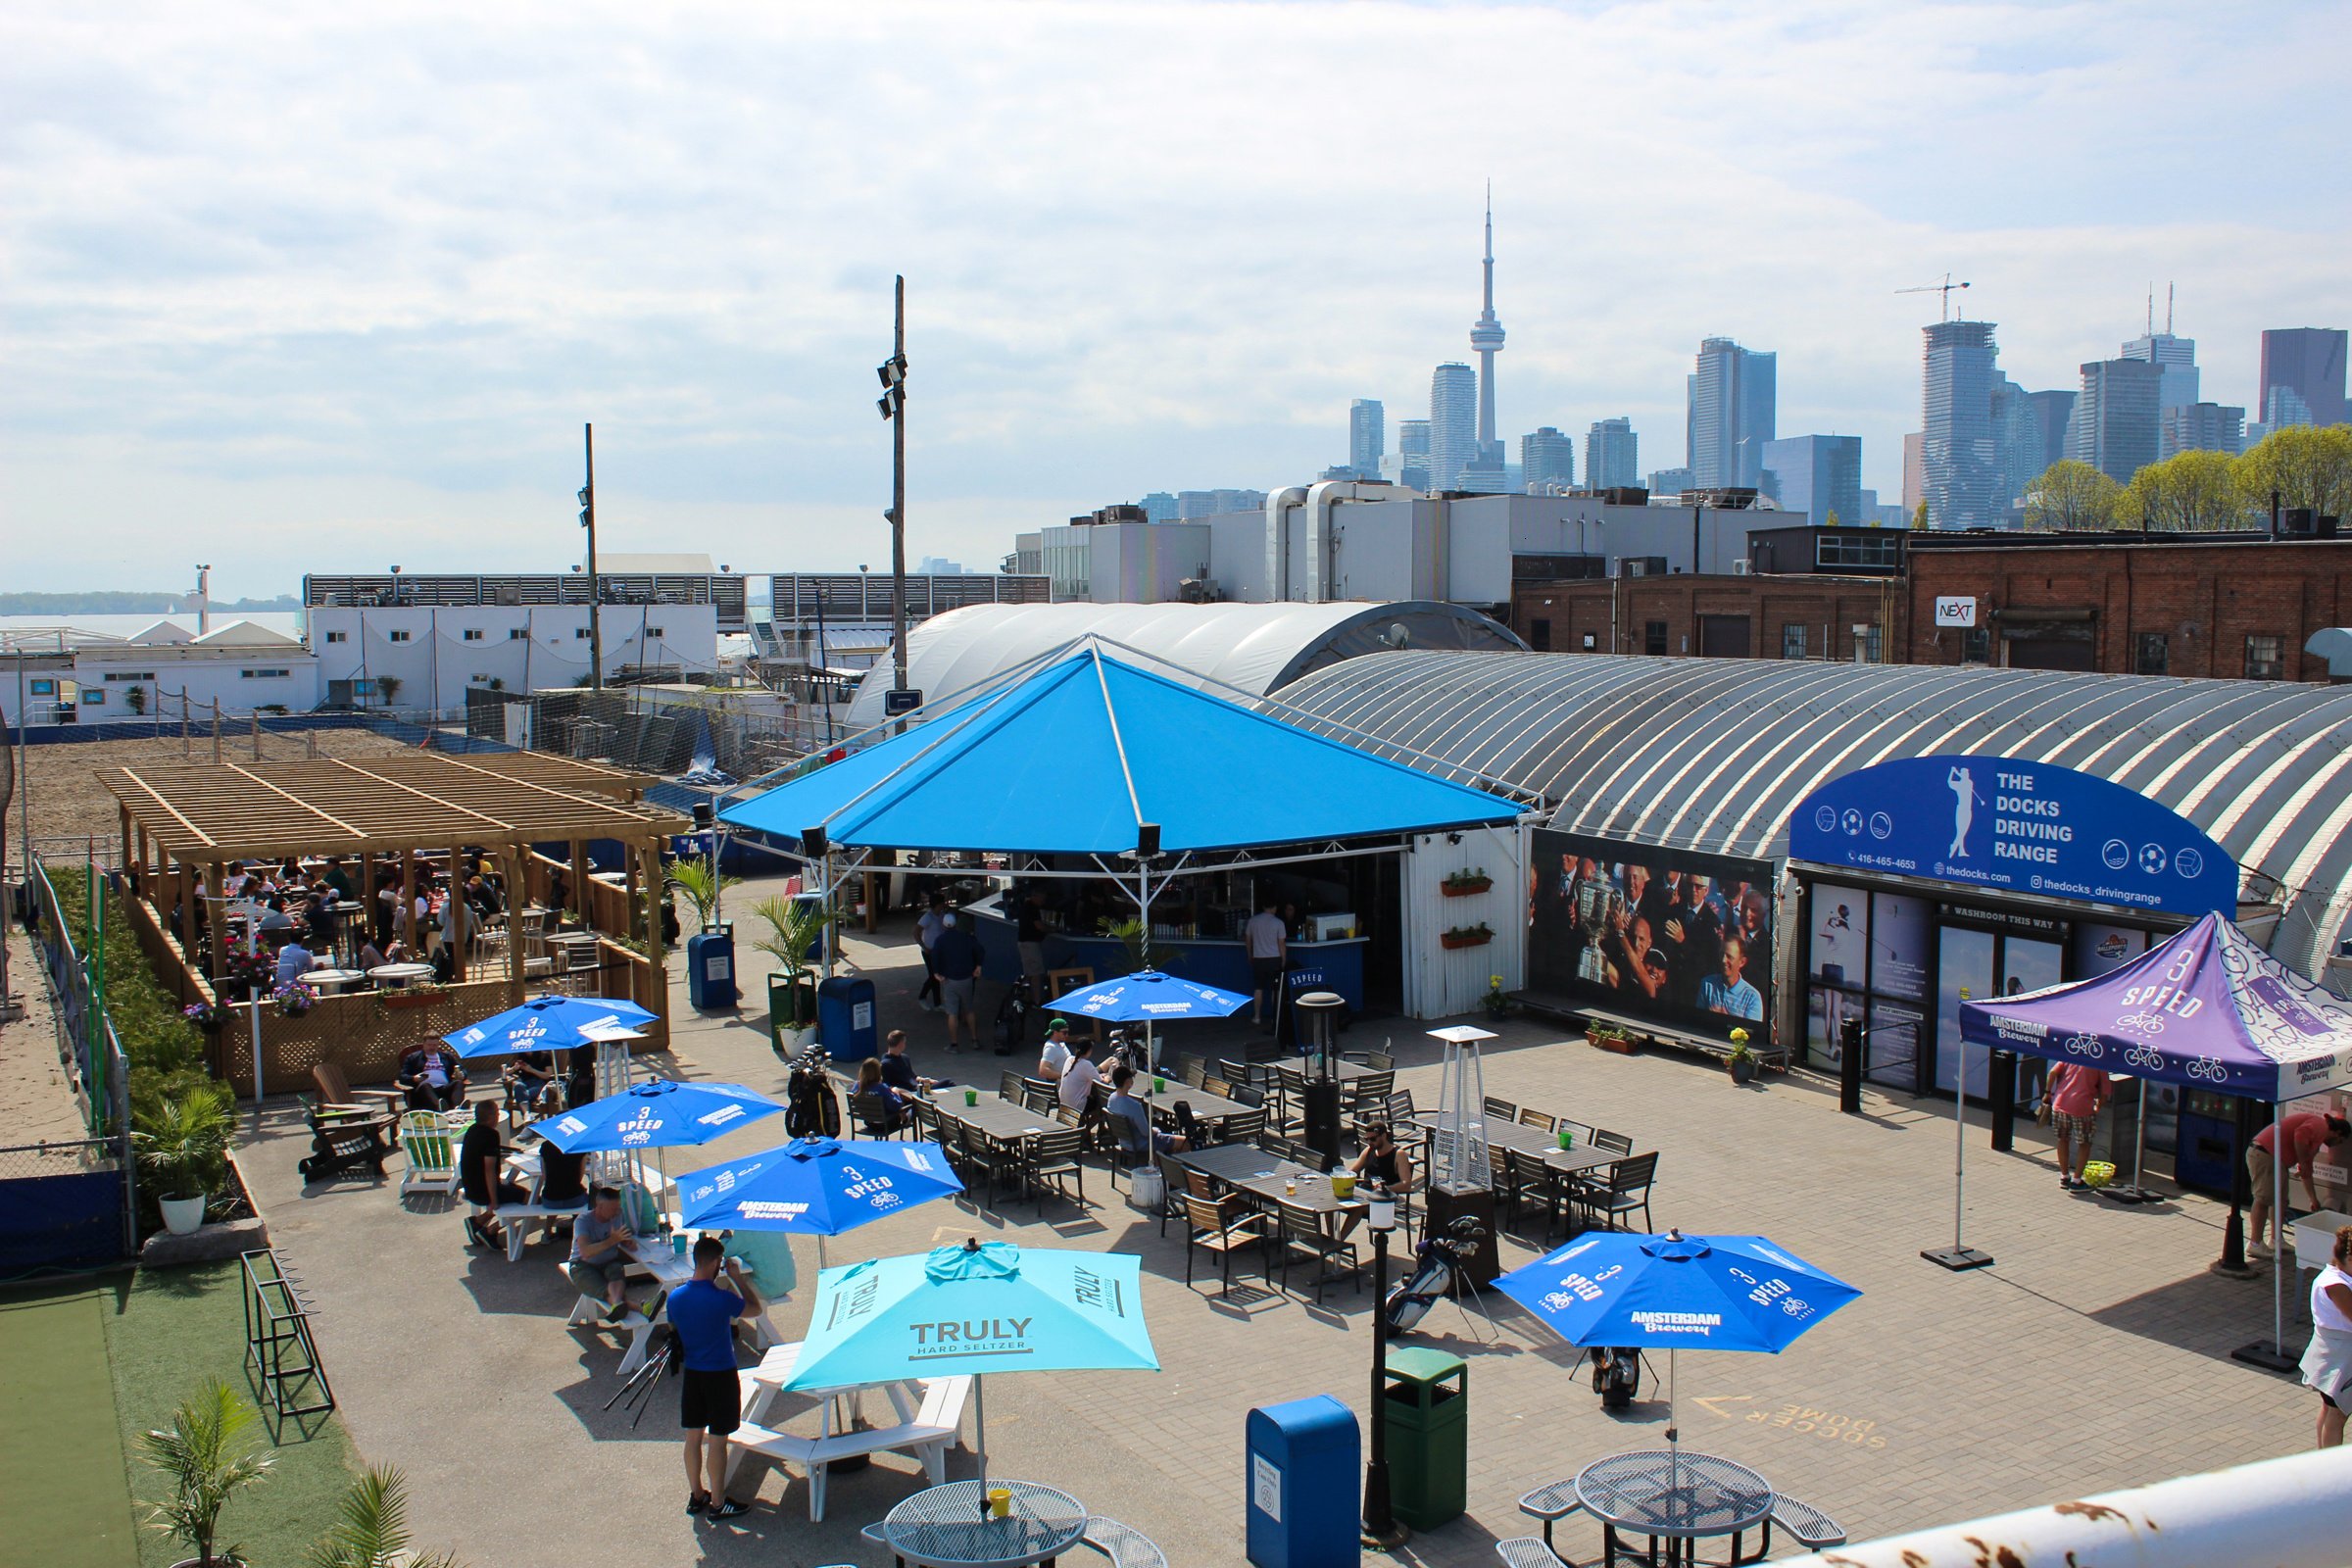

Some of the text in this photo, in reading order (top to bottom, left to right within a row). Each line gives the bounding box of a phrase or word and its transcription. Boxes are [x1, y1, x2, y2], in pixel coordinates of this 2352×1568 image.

[1939, 602, 1973, 620] NEXT
[1996, 772, 2034, 791] THE
[1996, 796, 2060, 817] DOCKS
[1995, 818, 2072, 842] DRIVING
[1857, 854, 1916, 870] 416-465-4653
[1994, 842, 2058, 863] RANGE
[2044, 879, 2161, 905] thedocks_drivingrange
[1954, 907, 2054, 930] WASHROOM THIS WAY
[2166, 949, 2194, 981] 3
[1142, 1002, 1192, 1010] AMSTERDAM
[2121, 986, 2203, 1019] SPEED
[527, 1016, 539, 1028] 3
[1989, 1015, 2048, 1038] AMSTERDAM
[509, 1027, 548, 1040] SPEED
[1998, 1028, 2040, 1048] Brewery
[2297, 1054, 2336, 1075] AMSTERDAM
[2301, 1070, 2329, 1085] Brewery
[638, 1106, 651, 1119] 3
[618, 1119, 663, 1133] SPEED
[843, 1165, 863, 1181] 3
[845, 1176, 894, 1200] SPEED
[737, 1200, 809, 1213] AMSTERDAM
[743, 1209, 796, 1222] Brewery
[1594, 1264, 1623, 1282] 3
[1729, 1267, 1757, 1285] 3
[847, 1274, 878, 1319] TRULY
[1074, 1265, 1103, 1308] TRULY
[1560, 1272, 1604, 1301] SPEED
[1748, 1278, 1792, 1307] SPEED
[1631, 1310, 1722, 1326] AMSTERDAM
[909, 1317, 1033, 1345] TRULY
[1642, 1322, 1710, 1337] Brewery
[917, 1341, 1025, 1354] HARD SELTZER
[1783, 1403, 1877, 1433] DOME
[1745, 1411, 1887, 1449] SOCCER
